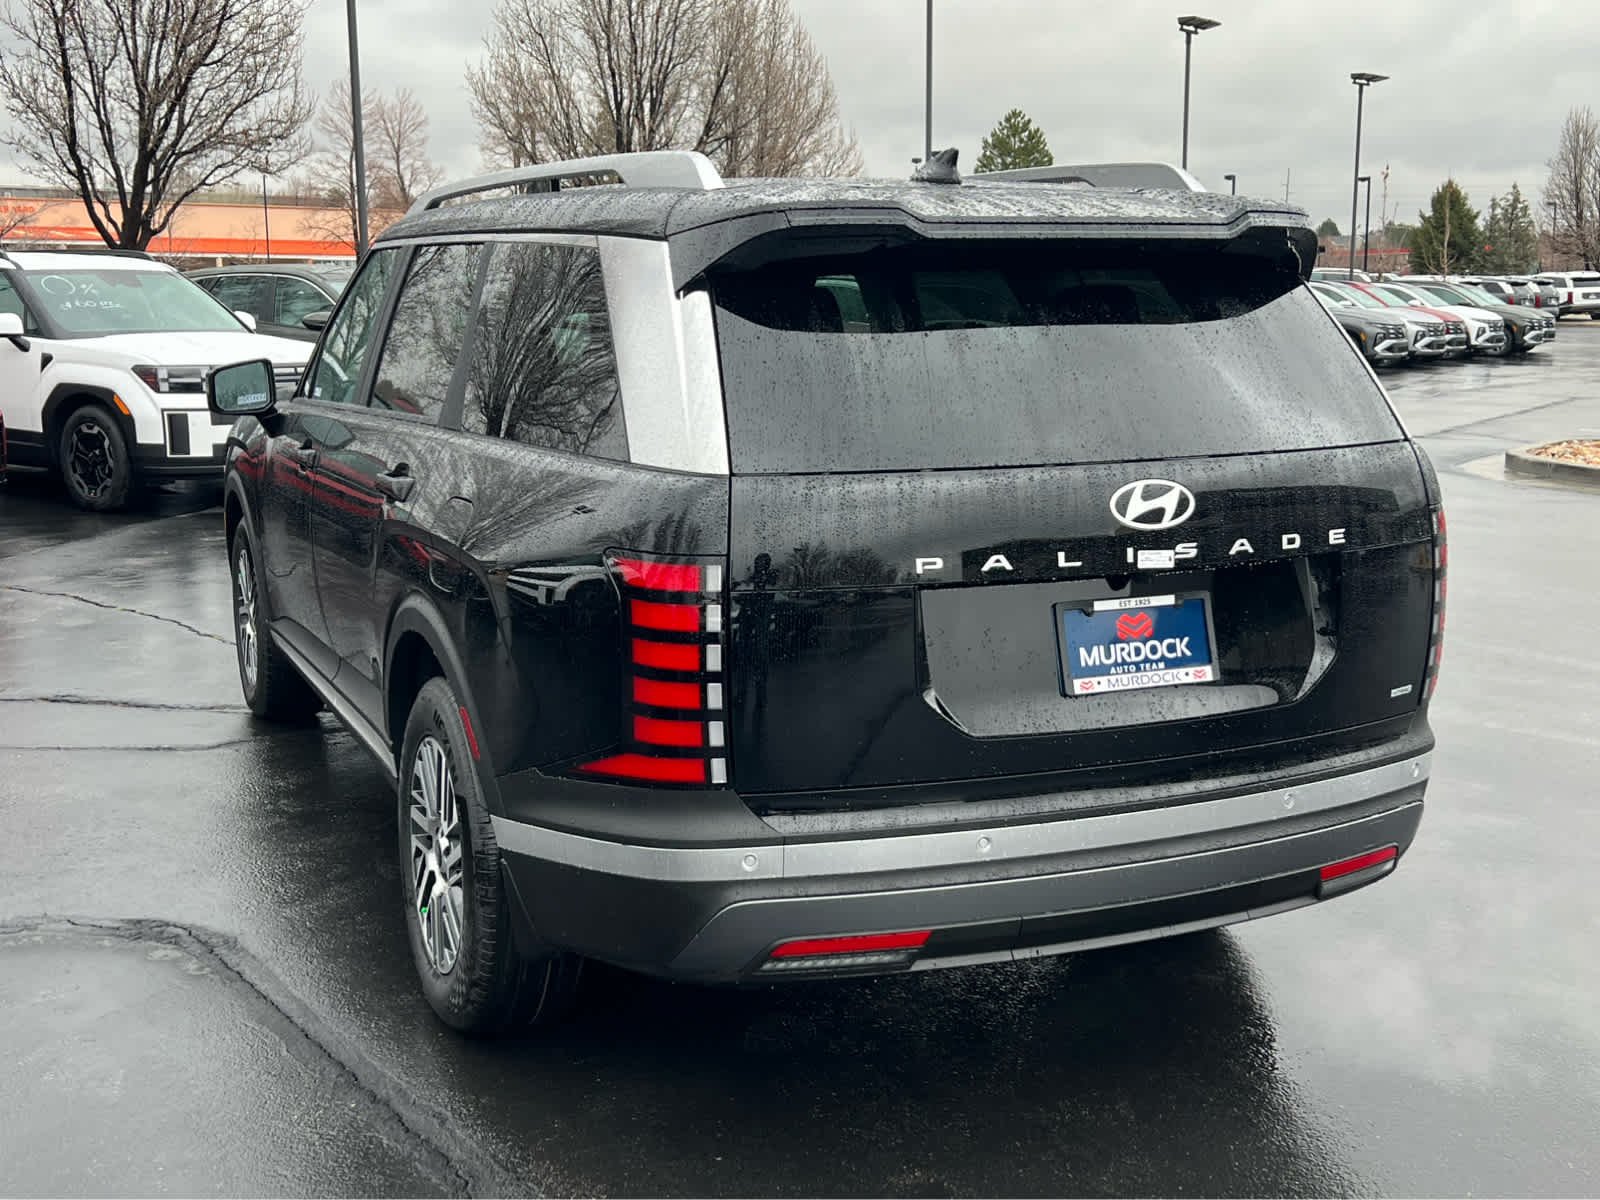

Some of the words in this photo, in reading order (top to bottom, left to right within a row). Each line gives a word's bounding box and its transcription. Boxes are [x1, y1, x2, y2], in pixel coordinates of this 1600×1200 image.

[915, 528, 1346, 574] PALISADE
[1079, 636, 1192, 667] MURDOCK
[1110, 663, 1137, 674] AUTO
[1140, 661, 1166, 671] TEAM
[1107, 671, 1182, 689] MURDOCK
